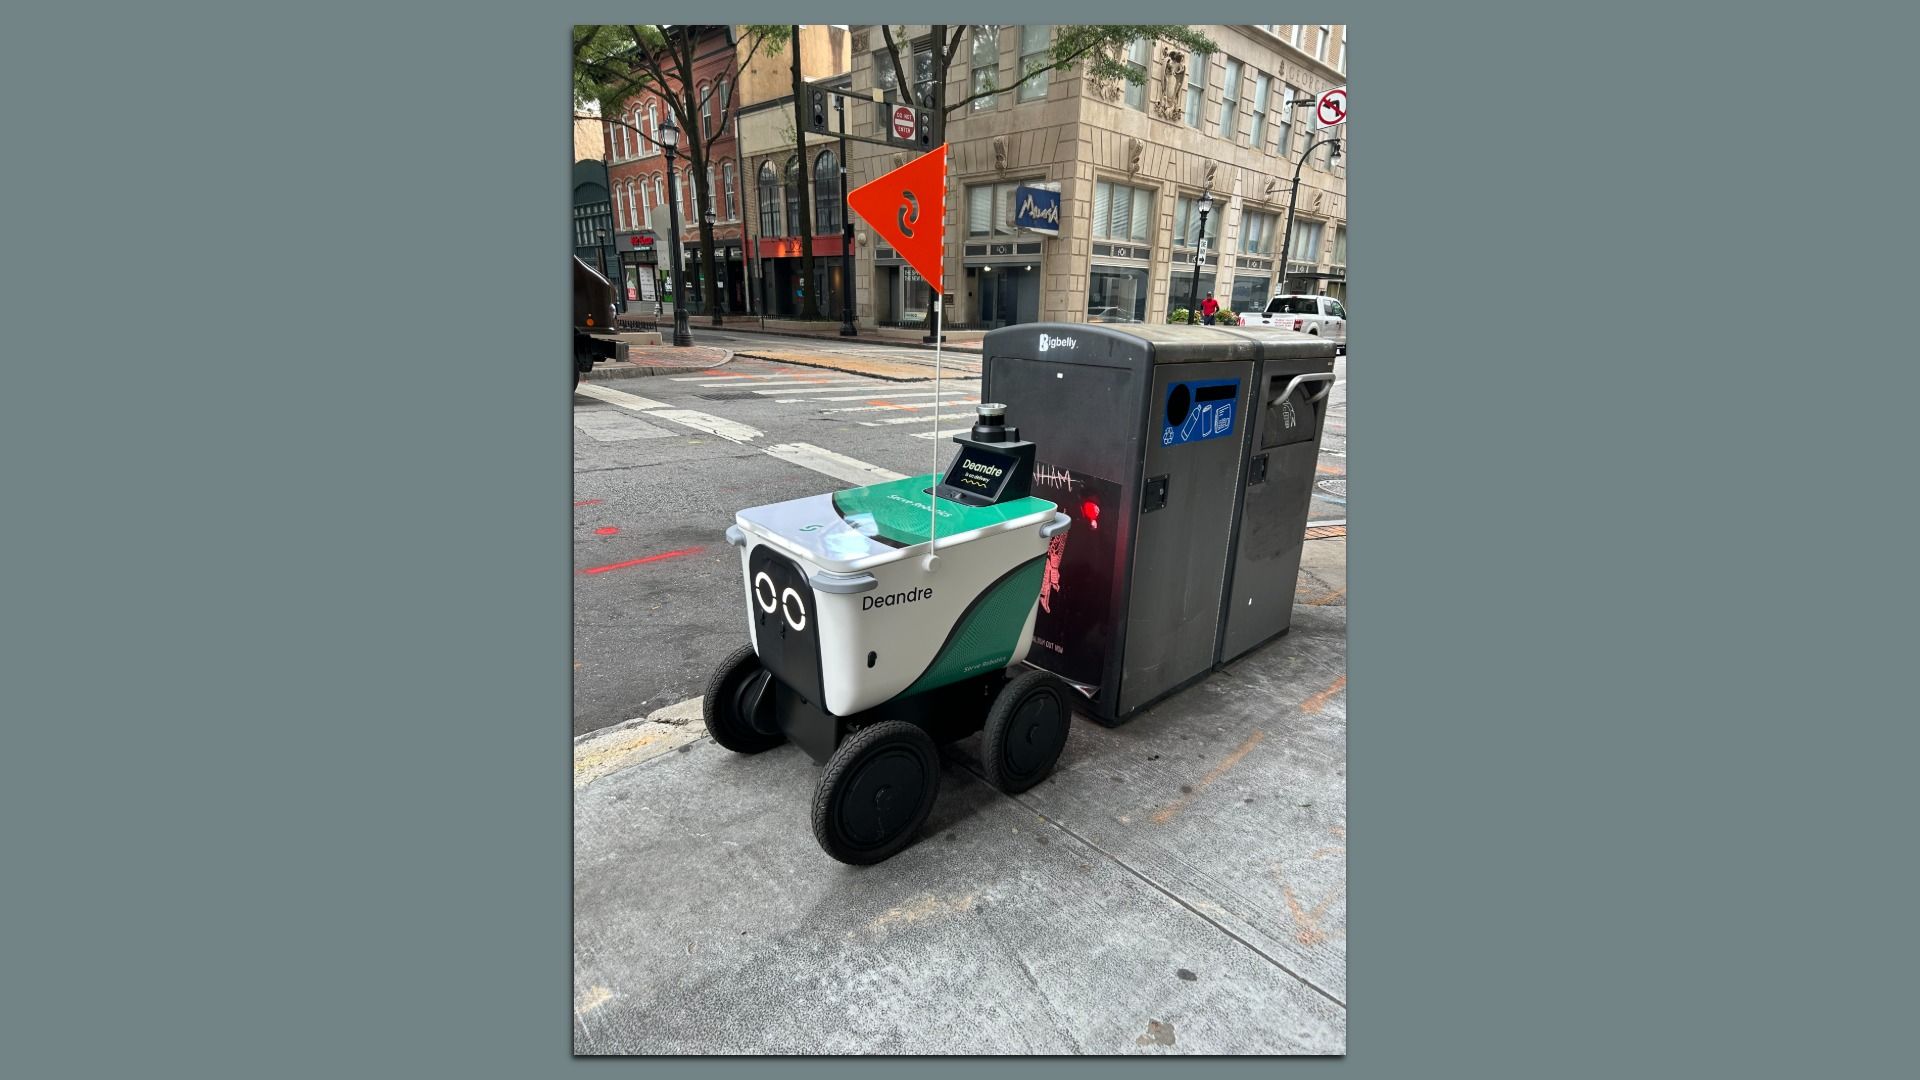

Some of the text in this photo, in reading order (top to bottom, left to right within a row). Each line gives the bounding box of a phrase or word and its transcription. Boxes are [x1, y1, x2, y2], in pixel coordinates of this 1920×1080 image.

[1040, 334, 1077, 351] Bigbelly
[963, 459, 1002, 477] Deandre
[974, 475, 990, 483] delivery
[862, 587, 933, 611] Deandre
[1045, 641, 1054, 650] OUT
[963, 656, 1007, 672] Serve Robotics
